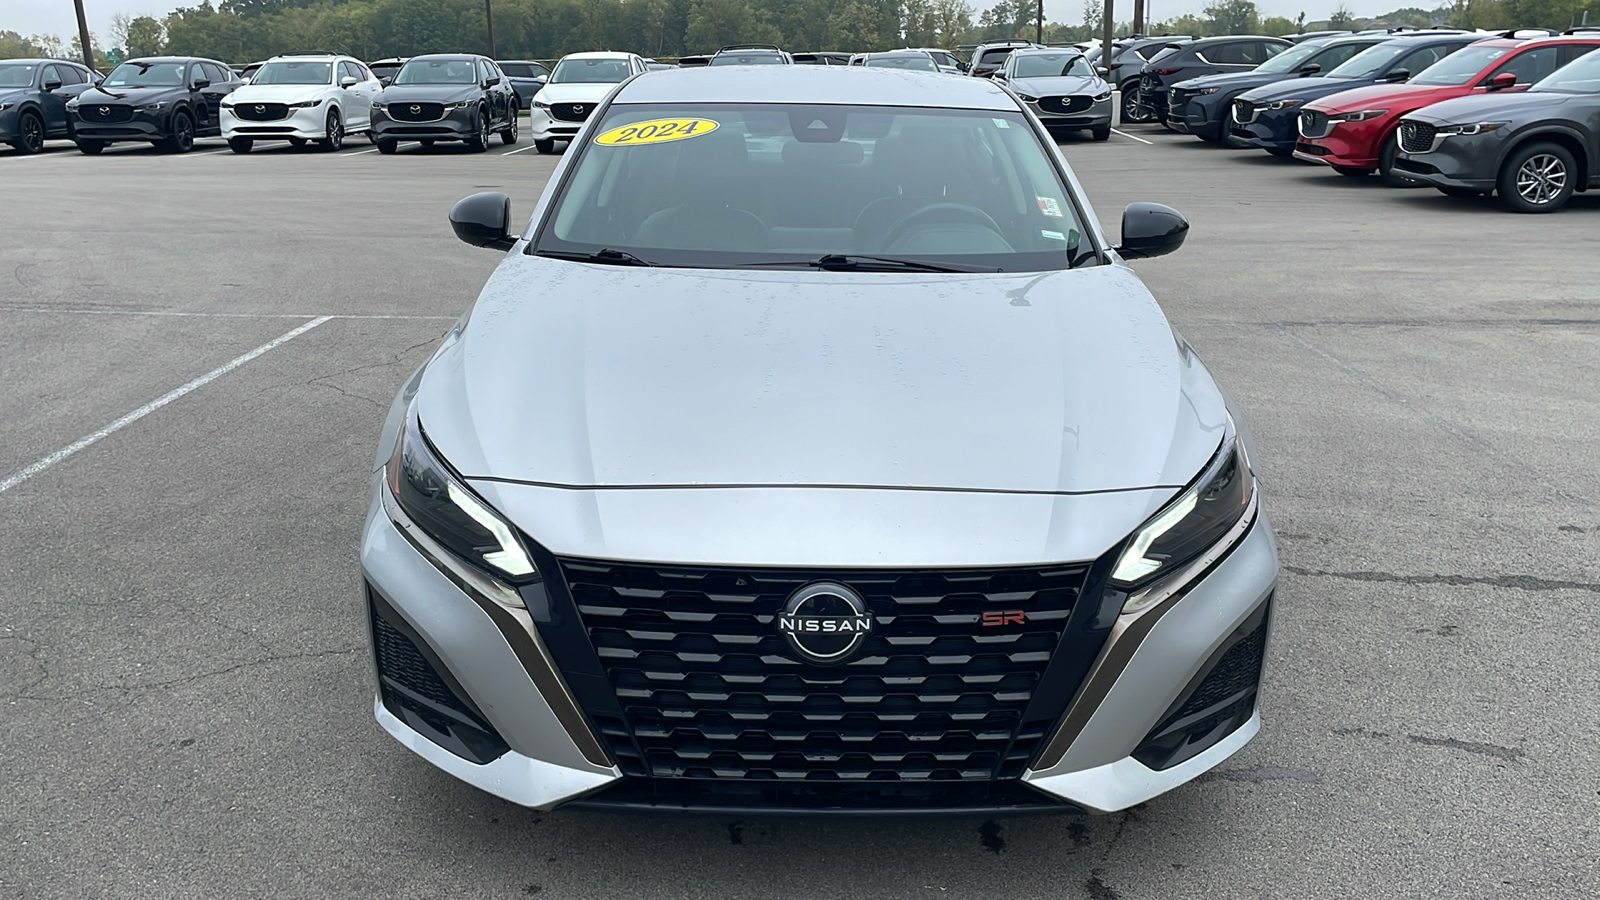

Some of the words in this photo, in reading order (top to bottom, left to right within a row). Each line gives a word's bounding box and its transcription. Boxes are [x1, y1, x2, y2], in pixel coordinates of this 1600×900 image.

[614, 121, 699, 143] 2024
[780, 617, 870, 632] NISSAN
[982, 610, 1025, 626] SR
